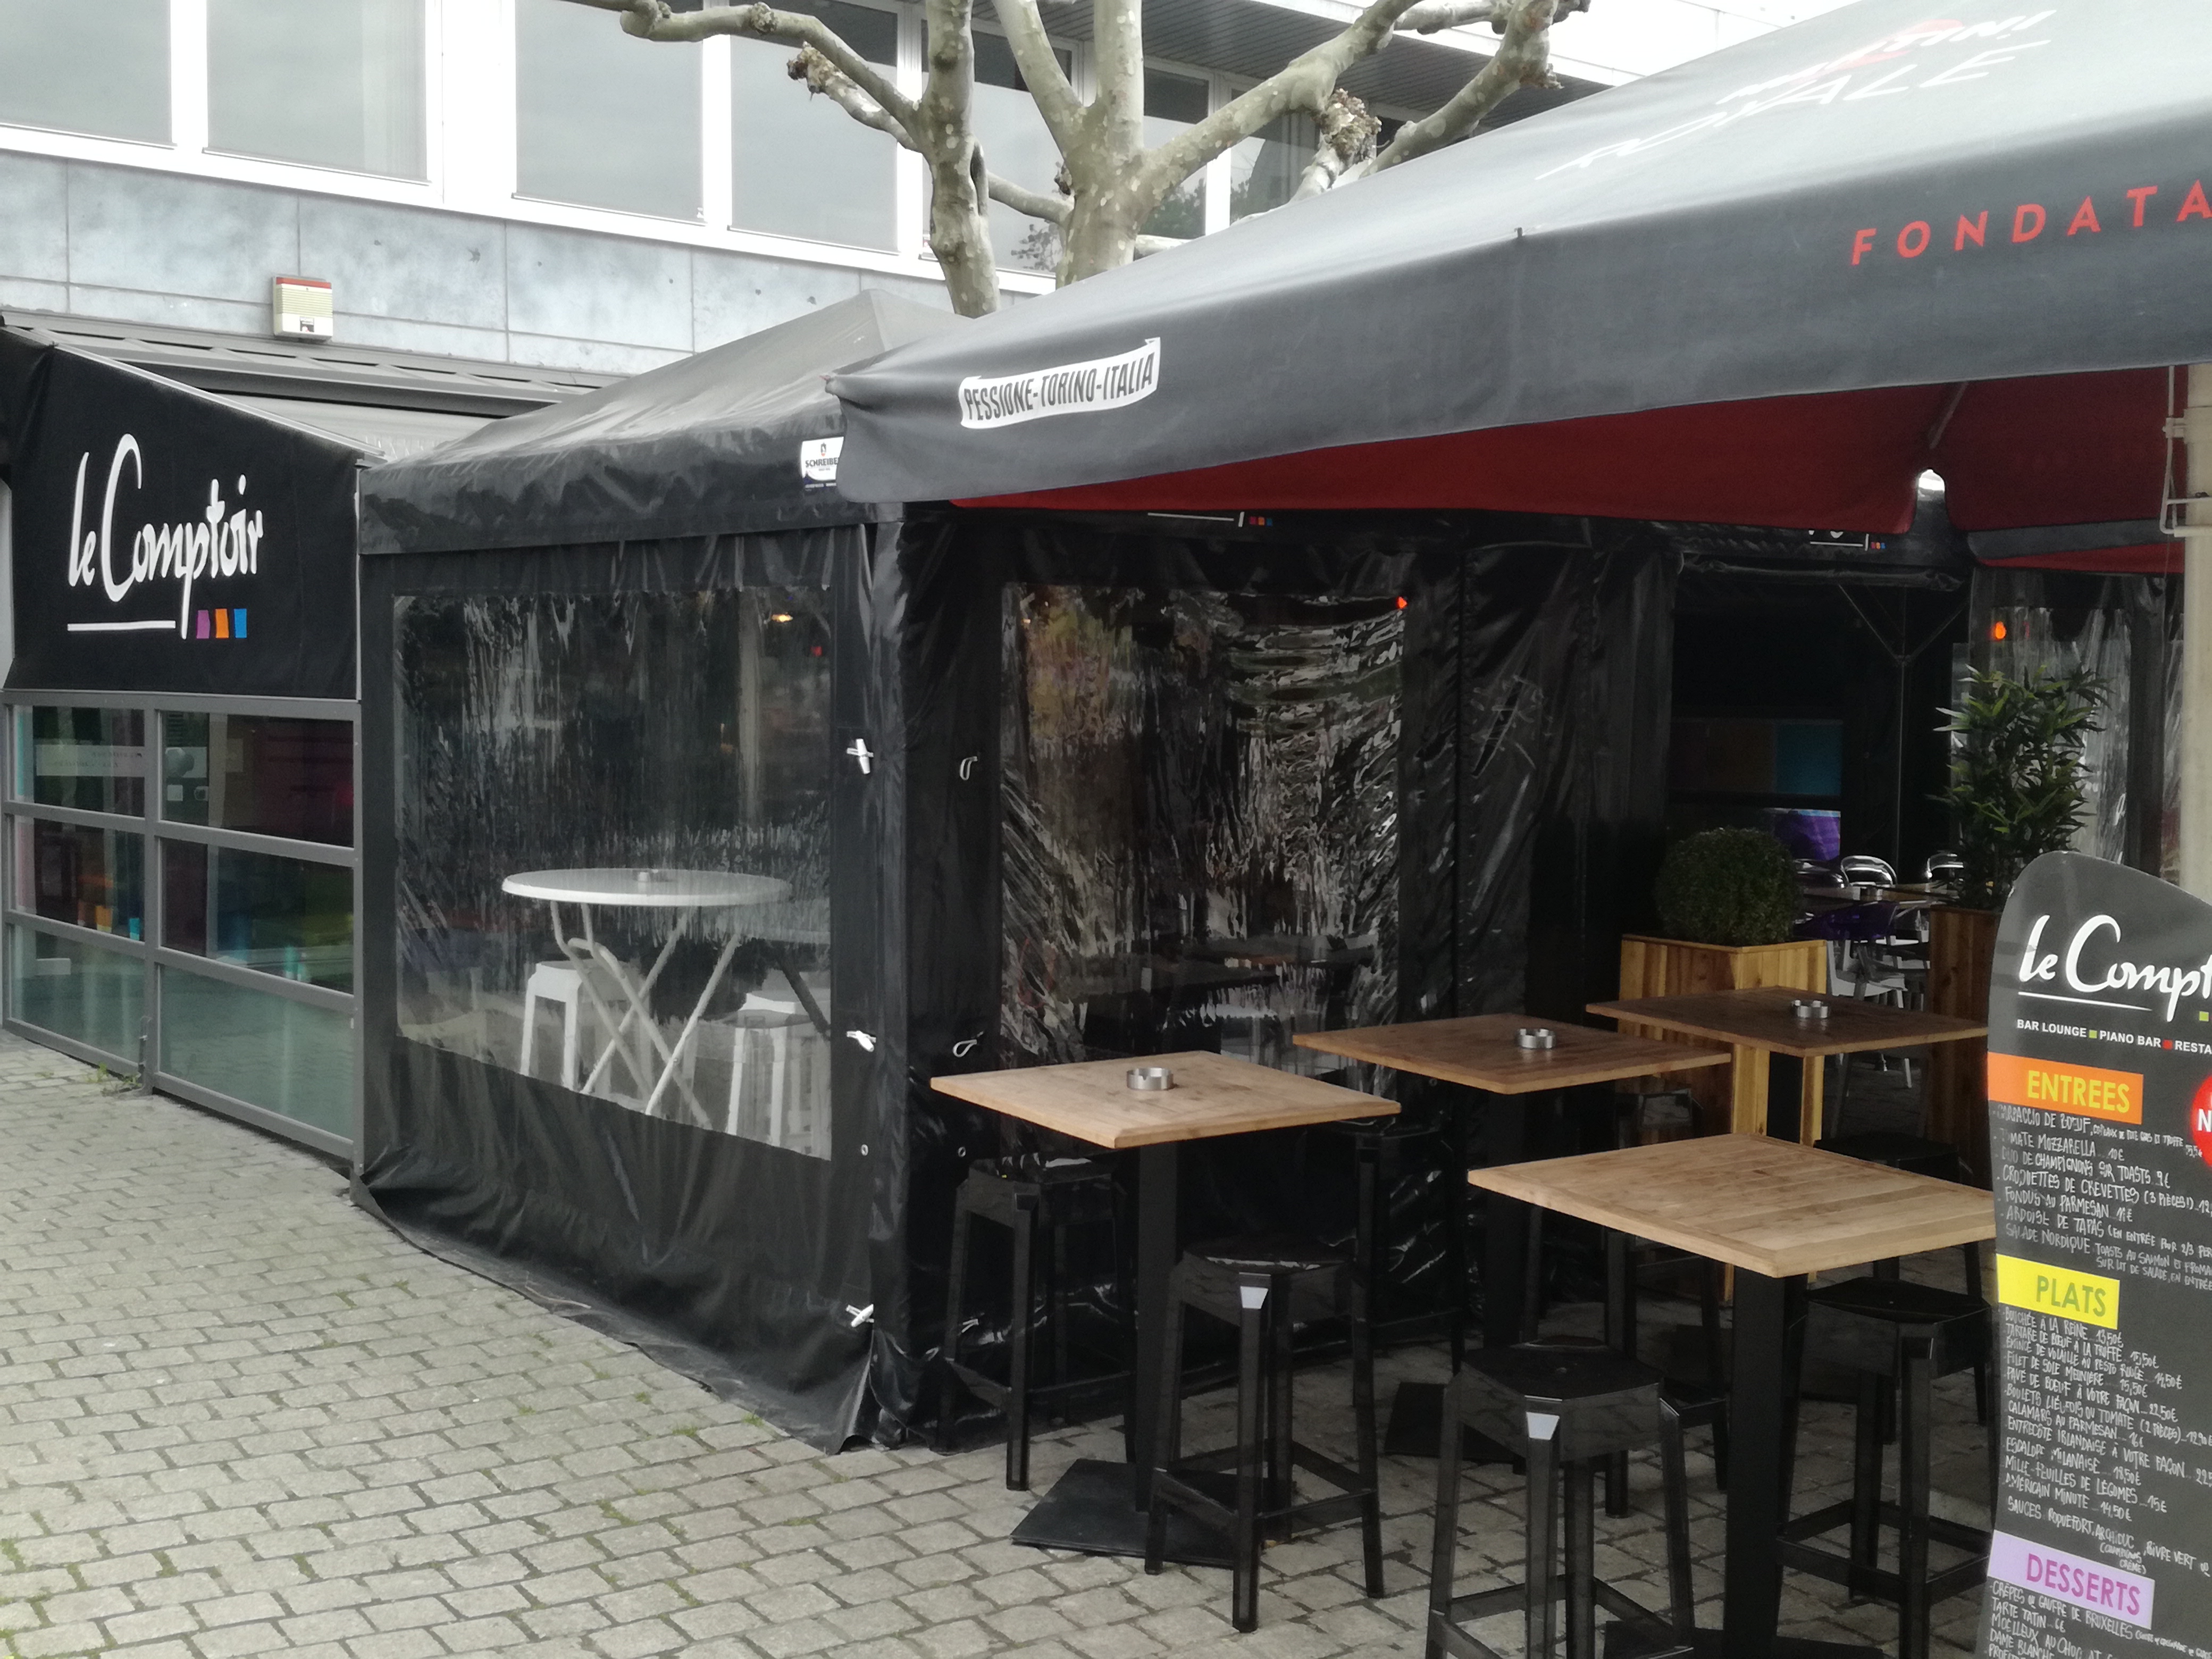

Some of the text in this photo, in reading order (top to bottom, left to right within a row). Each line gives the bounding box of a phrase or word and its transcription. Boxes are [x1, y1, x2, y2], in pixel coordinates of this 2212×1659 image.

[1851, 180, 2212, 266] FONDATA
[805, 457, 839, 467] SCHREIBE
[101, 433, 263, 639] Comptoir
[2017, 1019, 2212, 1055] BAR LOUNGE PIANO BAR RESTA
[2027, 1070, 2130, 1113] ENTREES
[2045, 1112, 2056, 1127] DE
[2038, 1134, 2096, 1157] MOZZARELLA
[2003, 1164, 2060, 1189] CROQUETTES
[2065, 1177, 2075, 1193] DE
[2023, 1151, 2033, 1165] DE
[2099, 1161, 2115, 1182] SUR
[2117, 1166, 2151, 1184] TOASTS
[2046, 1194, 2055, 1208] AU
[2060, 1195, 2109, 1218] PARMESAN
[2057, 1214, 2069, 1229] DE
[2074, 1218, 2104, 1237] TAPAS
[2095, 1243, 2123, 1258] TOASTS
[2127, 1250, 2136, 1261] AU
[2138, 1252, 2169, 1267] SAUMON
[2096, 1256, 2114, 1270] SUR
[2130, 1264, 2140, 1274] DE
[2036, 1275, 2106, 1317] PLATS
[2049, 1318, 2059, 1333] LA
[2006, 1323, 2037, 1342] TARTARE
[2040, 1330, 2048, 1344] DE
[2083, 1342, 2092, 1357] LA
[2094, 1344, 2122, 1362] TRUFFE
[2031, 1356, 2040, 1370] DE
[2042, 1359, 2060, 1375] SOLE
[2036, 1343, 2046, 1356] DE
[2082, 1358, 2091, 1369] AU
[2095, 1359, 2117, 1375] PESTO
[2030, 1373, 2040, 1388] DE
[2087, 1388, 2110, 1406] VOTRE
[2006, 1383, 2041, 1406] BOULETS
[2085, 1406, 2095, 1419] OU
[2098, 1409, 2134, 1430] TOMATE
[2008, 1400, 2052, 1426] CALAMARS
[2056, 1415, 2065, 1427] AU
[2069, 1416, 2117, 1439] PARMESAN
[2123, 1447, 2150, 1470] VOTRE
[2055, 1487, 2090, 1509] MINUTE
[2081, 1476, 2091, 1491] DE
[2148, 1495, 2167, 1512] 15€
[2008, 1495, 2041, 1519] SAUCES
[2174, 1551, 2197, 1570] VERT
[2027, 1553, 2140, 1615] DESSERTS
[1991, 1596, 2018, 1618] TARTE
[2022, 1608, 2046, 1628] TATIN
[2039, 1596, 2067, 1617] GAUFRE
[2071, 1606, 2082, 1622] DE
[2085, 1610, 2133, 1639] BRUXELLES
[1990, 1628, 2014, 1648] DAME
[2046, 1635, 2056, 1650] AU
